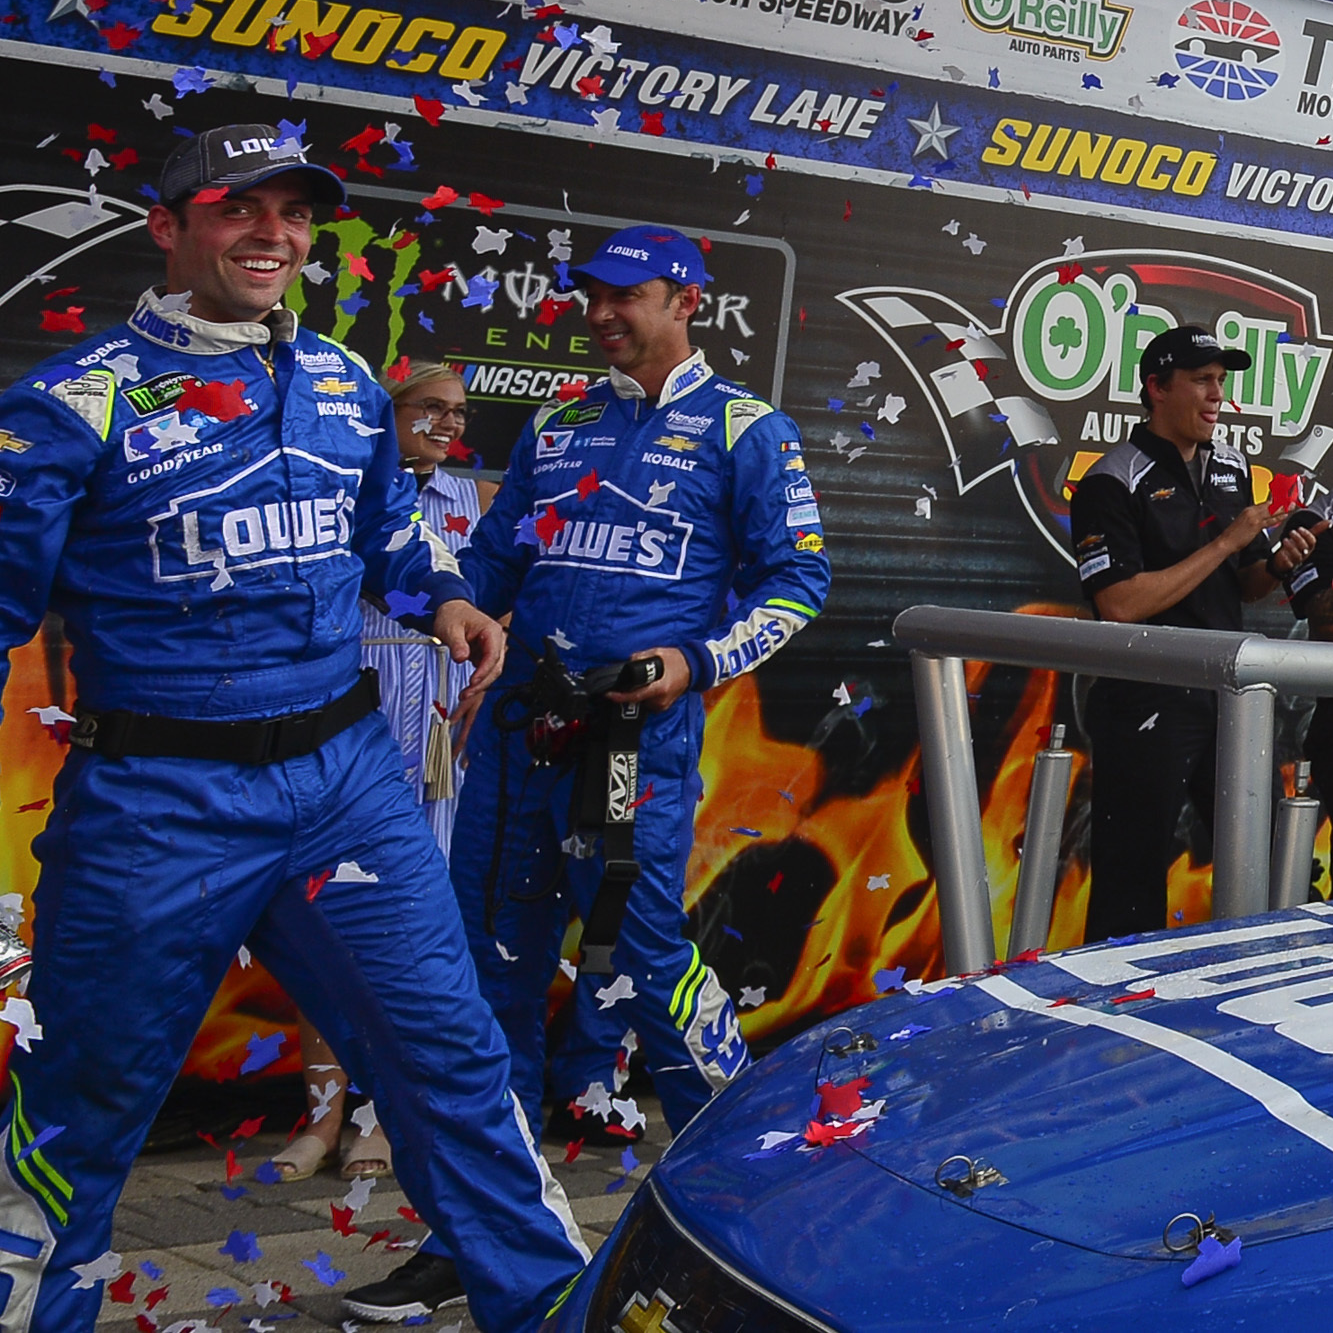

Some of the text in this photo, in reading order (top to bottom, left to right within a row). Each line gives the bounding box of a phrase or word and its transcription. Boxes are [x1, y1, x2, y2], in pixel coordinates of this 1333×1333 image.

[1009, 39, 1081, 64] AUTO PARTS
[518, 43, 750, 116] VICTORY
[749, 82, 887, 140] LANE
[981, 117, 1218, 197] SUNOCO
[607, 244, 650, 262] LOWE'S
[133, 302, 192, 348] LOWE'S
[486, 327, 591, 355] ENE
[76, 338, 132, 367] KOBALT
[295, 348, 344, 367] Hendrick
[1013, 271, 1333, 440] O'Rilly
[666, 410, 716, 429] Hendrick
[1080, 411, 1143, 443] AUT
[127, 442, 223, 484] GOODYEAR
[641, 451, 698, 472] KOBALT
[182, 489, 356, 566] LOWE'S
[538, 520, 669, 567] OWE'S
[715, 619, 787, 680] LOWE'S
